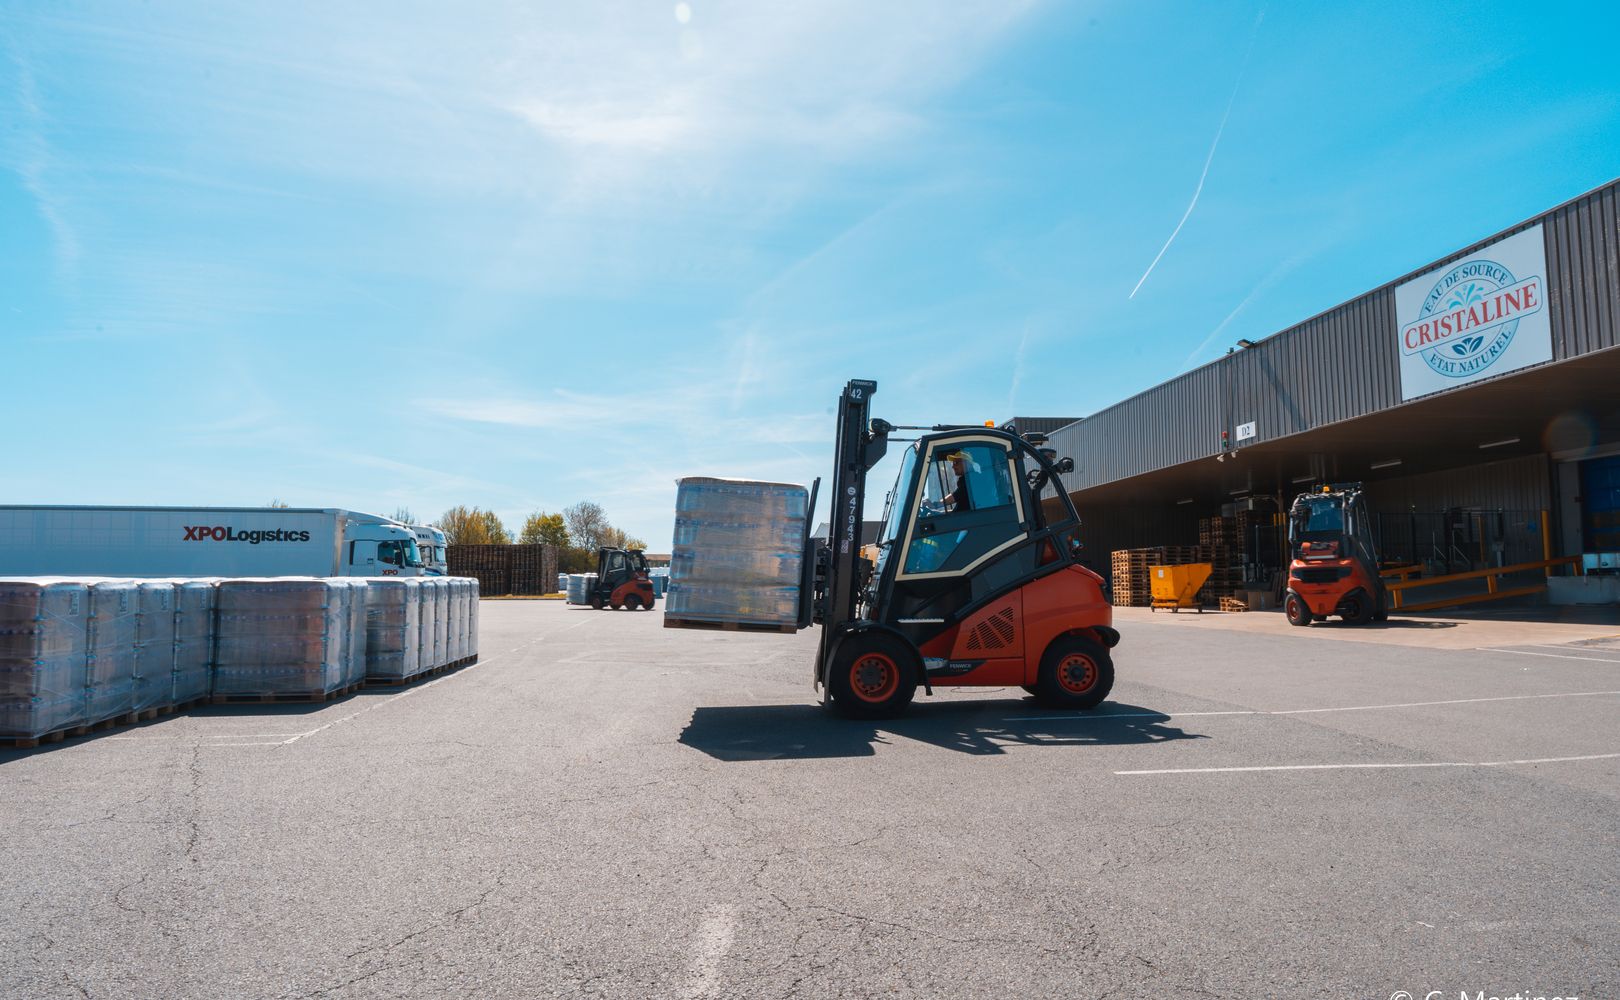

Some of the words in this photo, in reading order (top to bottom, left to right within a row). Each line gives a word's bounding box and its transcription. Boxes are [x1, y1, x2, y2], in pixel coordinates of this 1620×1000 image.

[1425, 286, 1444, 312] EAU
[1445, 271, 1461, 288] DE
[1462, 264, 1508, 285] SOURCE
[1405, 283, 1537, 349] CRISTALINE
[1430, 353, 1457, 373] ETAT
[1458, 330, 1511, 373] NATUREL
[850, 388, 862, 399] 42
